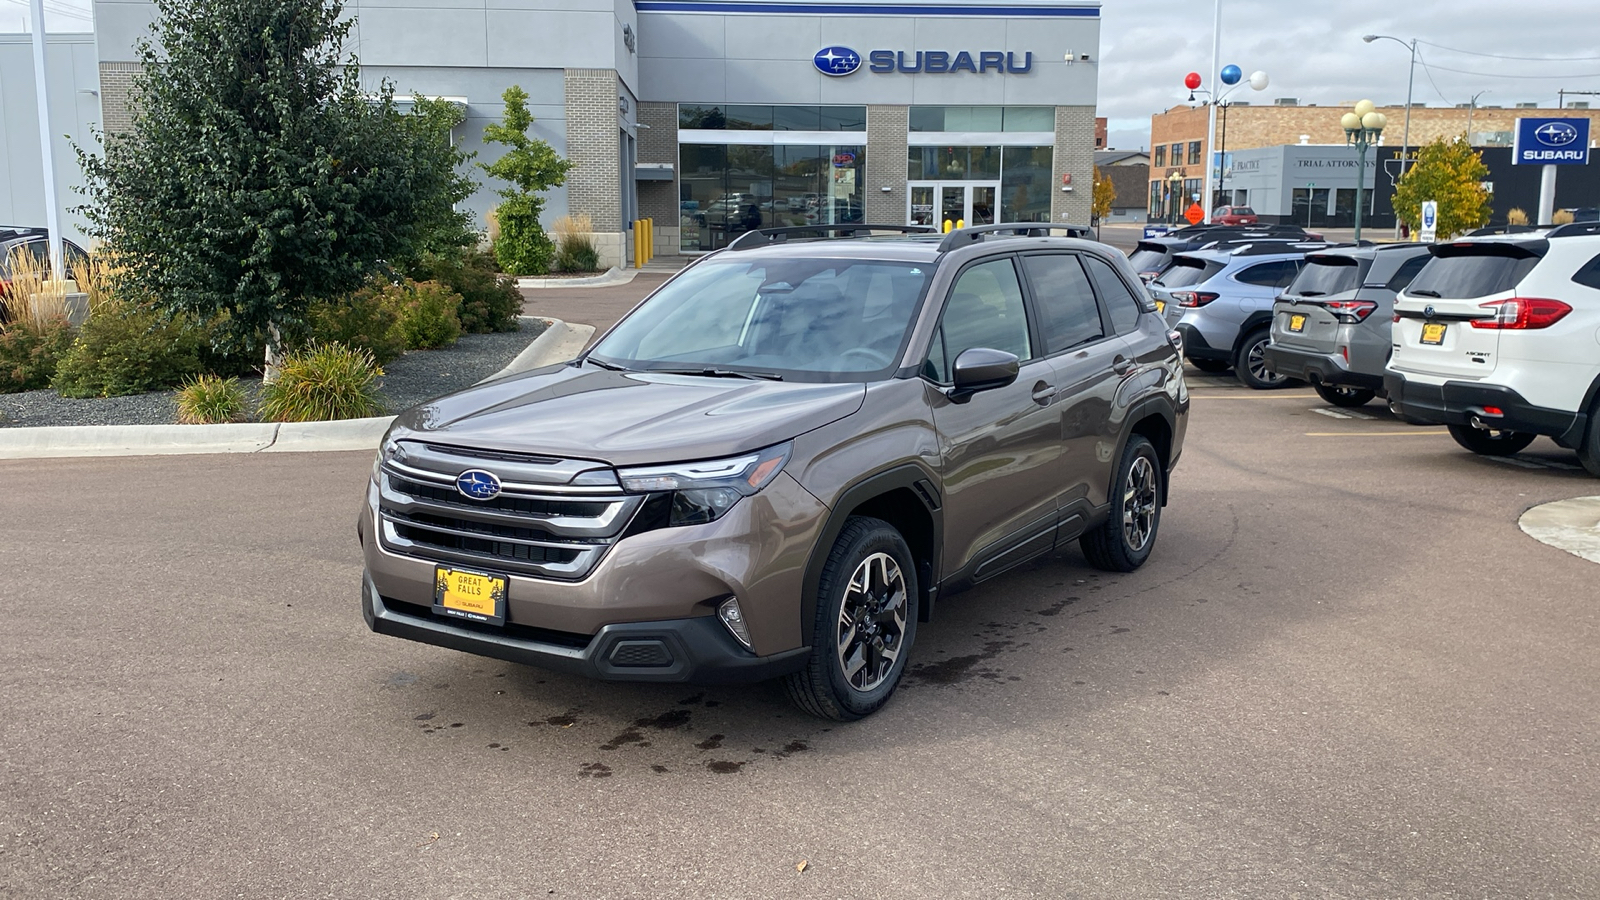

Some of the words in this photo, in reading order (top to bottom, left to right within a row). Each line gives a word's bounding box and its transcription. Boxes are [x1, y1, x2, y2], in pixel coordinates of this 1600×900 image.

[870, 50, 1032, 74] SUBARU
[1523, 150, 1584, 160] SUBARU
[1237, 160, 1260, 171] PRACTICE
[1298, 160, 1324, 168] TRIAL
[1326, 160, 1376, 168] ATTORNYS
[458, 575, 481, 586] GREAT
[458, 584, 481, 596] FALLS
